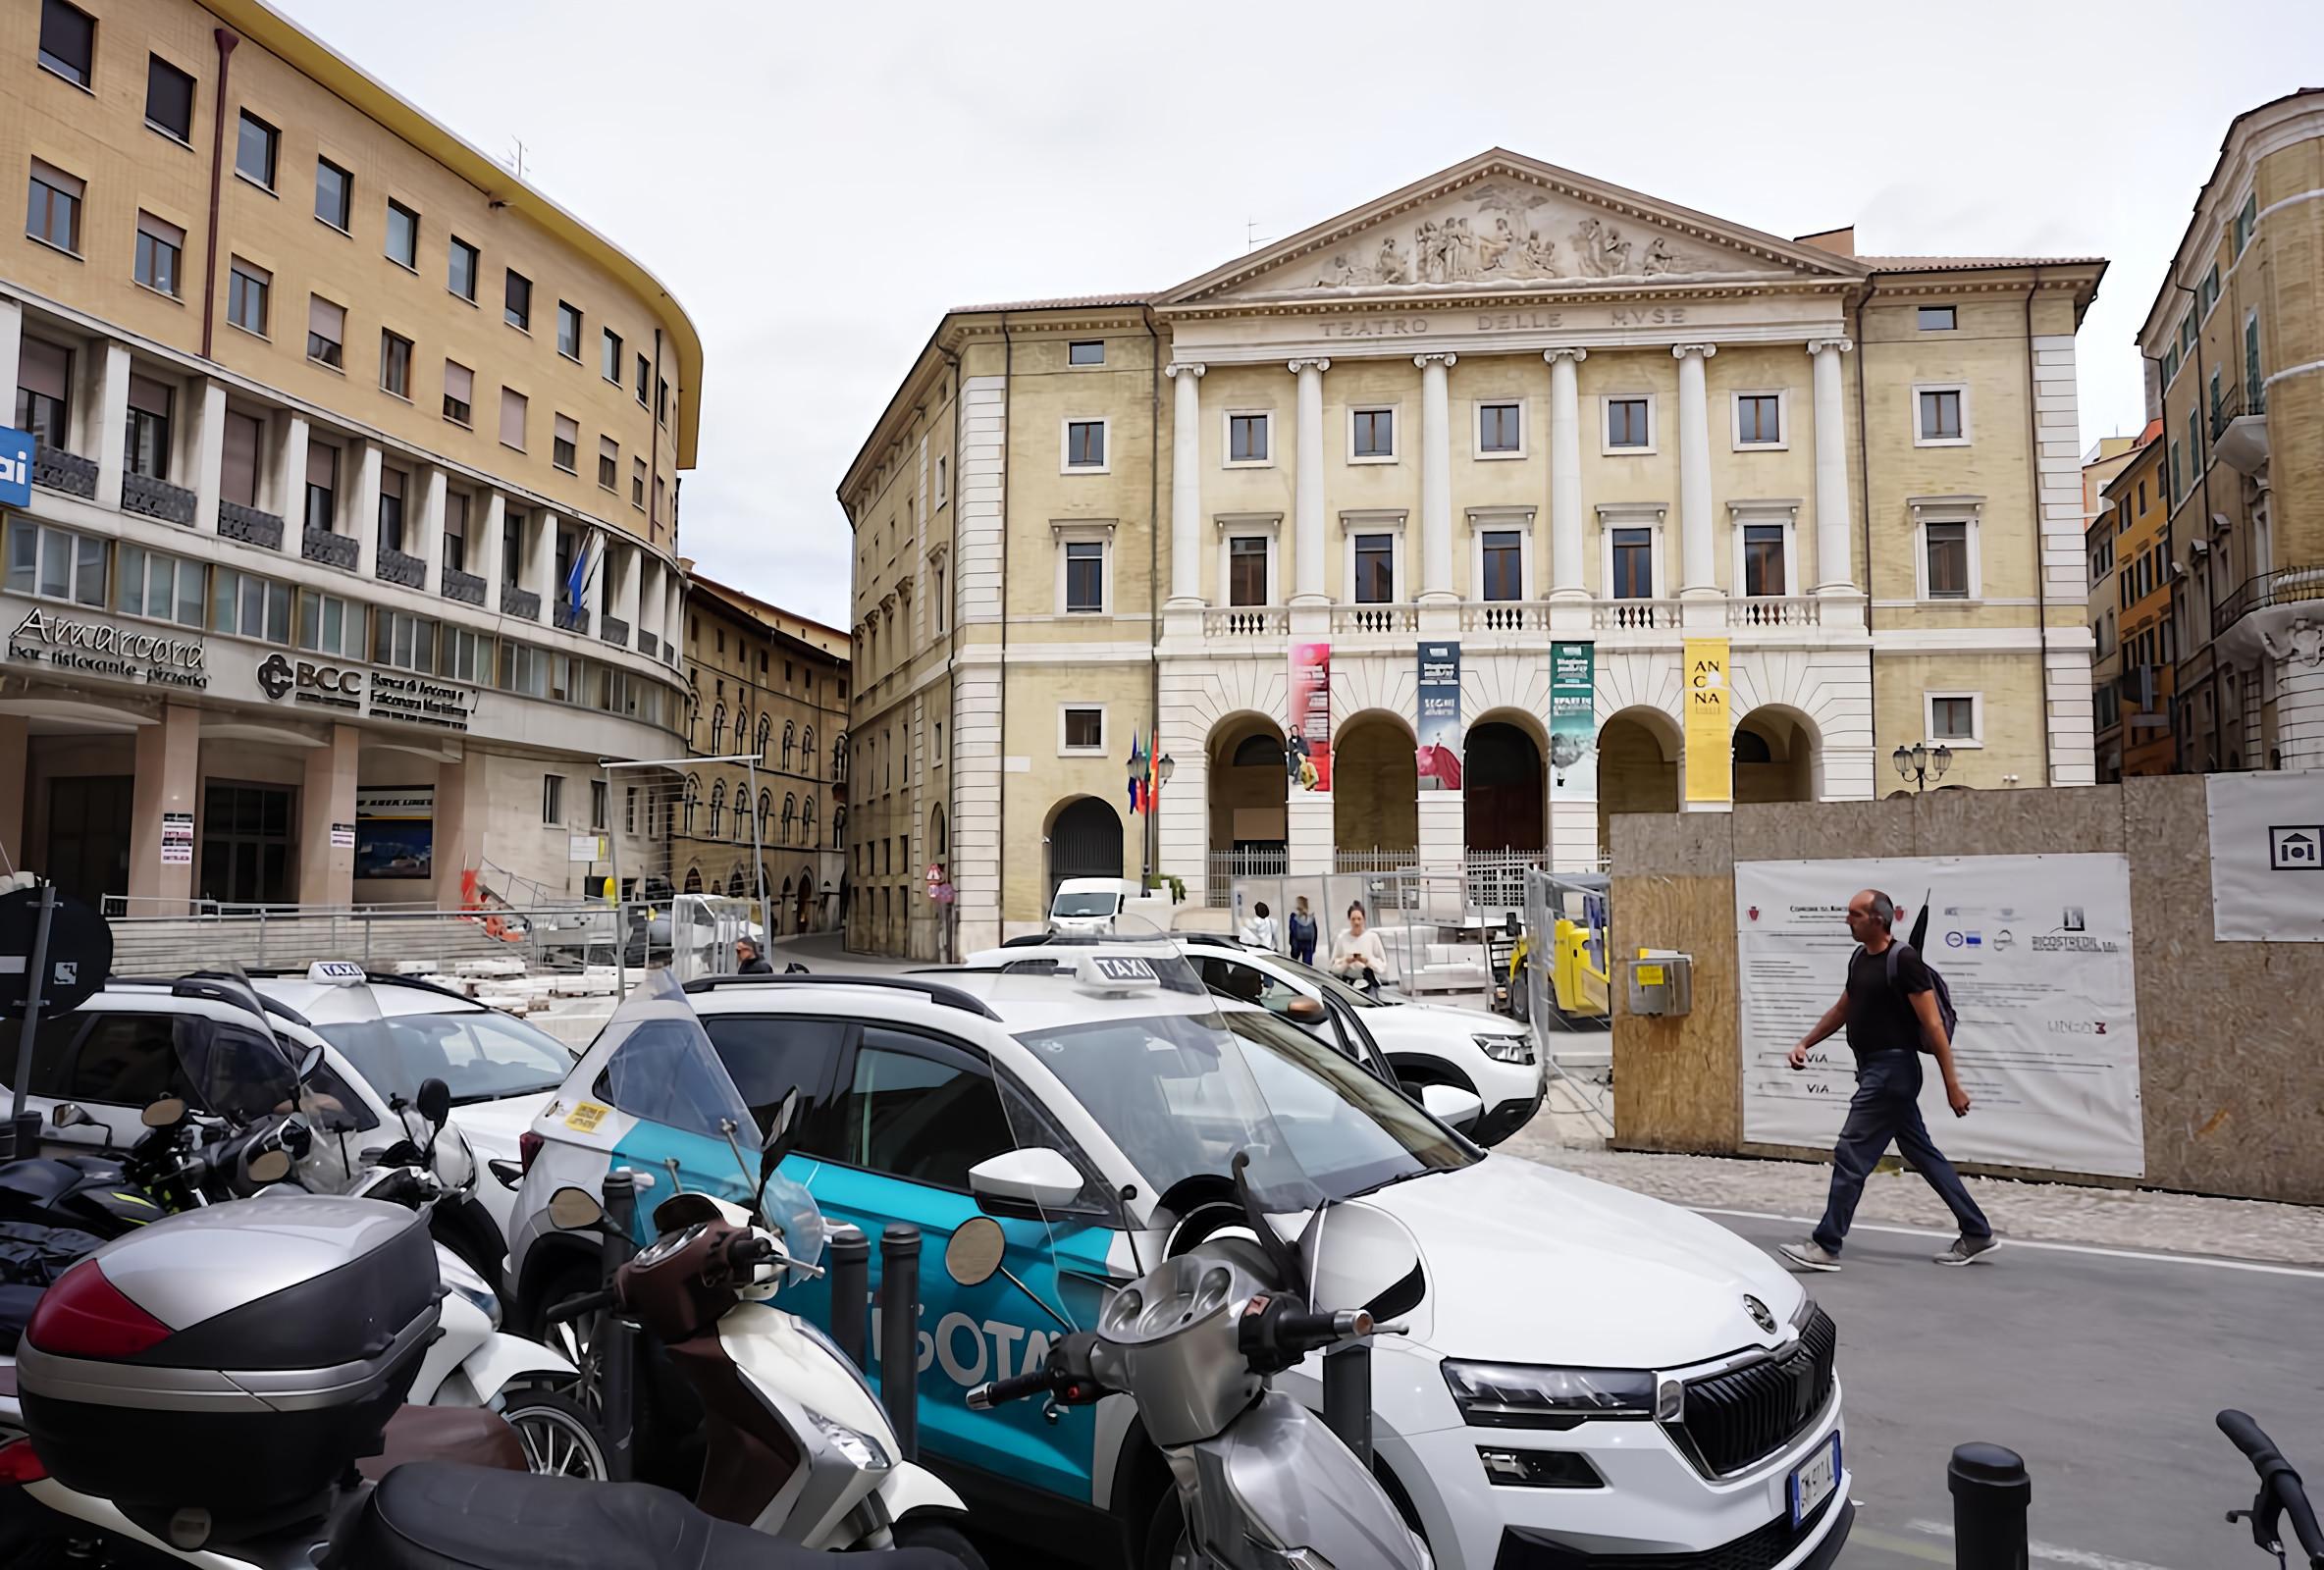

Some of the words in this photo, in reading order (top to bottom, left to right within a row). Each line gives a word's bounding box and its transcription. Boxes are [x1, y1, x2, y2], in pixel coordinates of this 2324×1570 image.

[1319, 318, 1428, 338] TEATRO
[1477, 313, 1562, 331] DELLE
[9, 605, 205, 669] Amarcord
[8, 640, 41, 661] bar
[52, 649, 137, 677] ristorante
[147, 666, 208, 690] pizzeria
[1694, 660, 1719, 672] AN
[296, 661, 362, 696] BCC
[1695, 692, 1719, 705] NA
[321, 964, 361, 975] TAXI
[1095, 959, 1152, 977] TAXI
